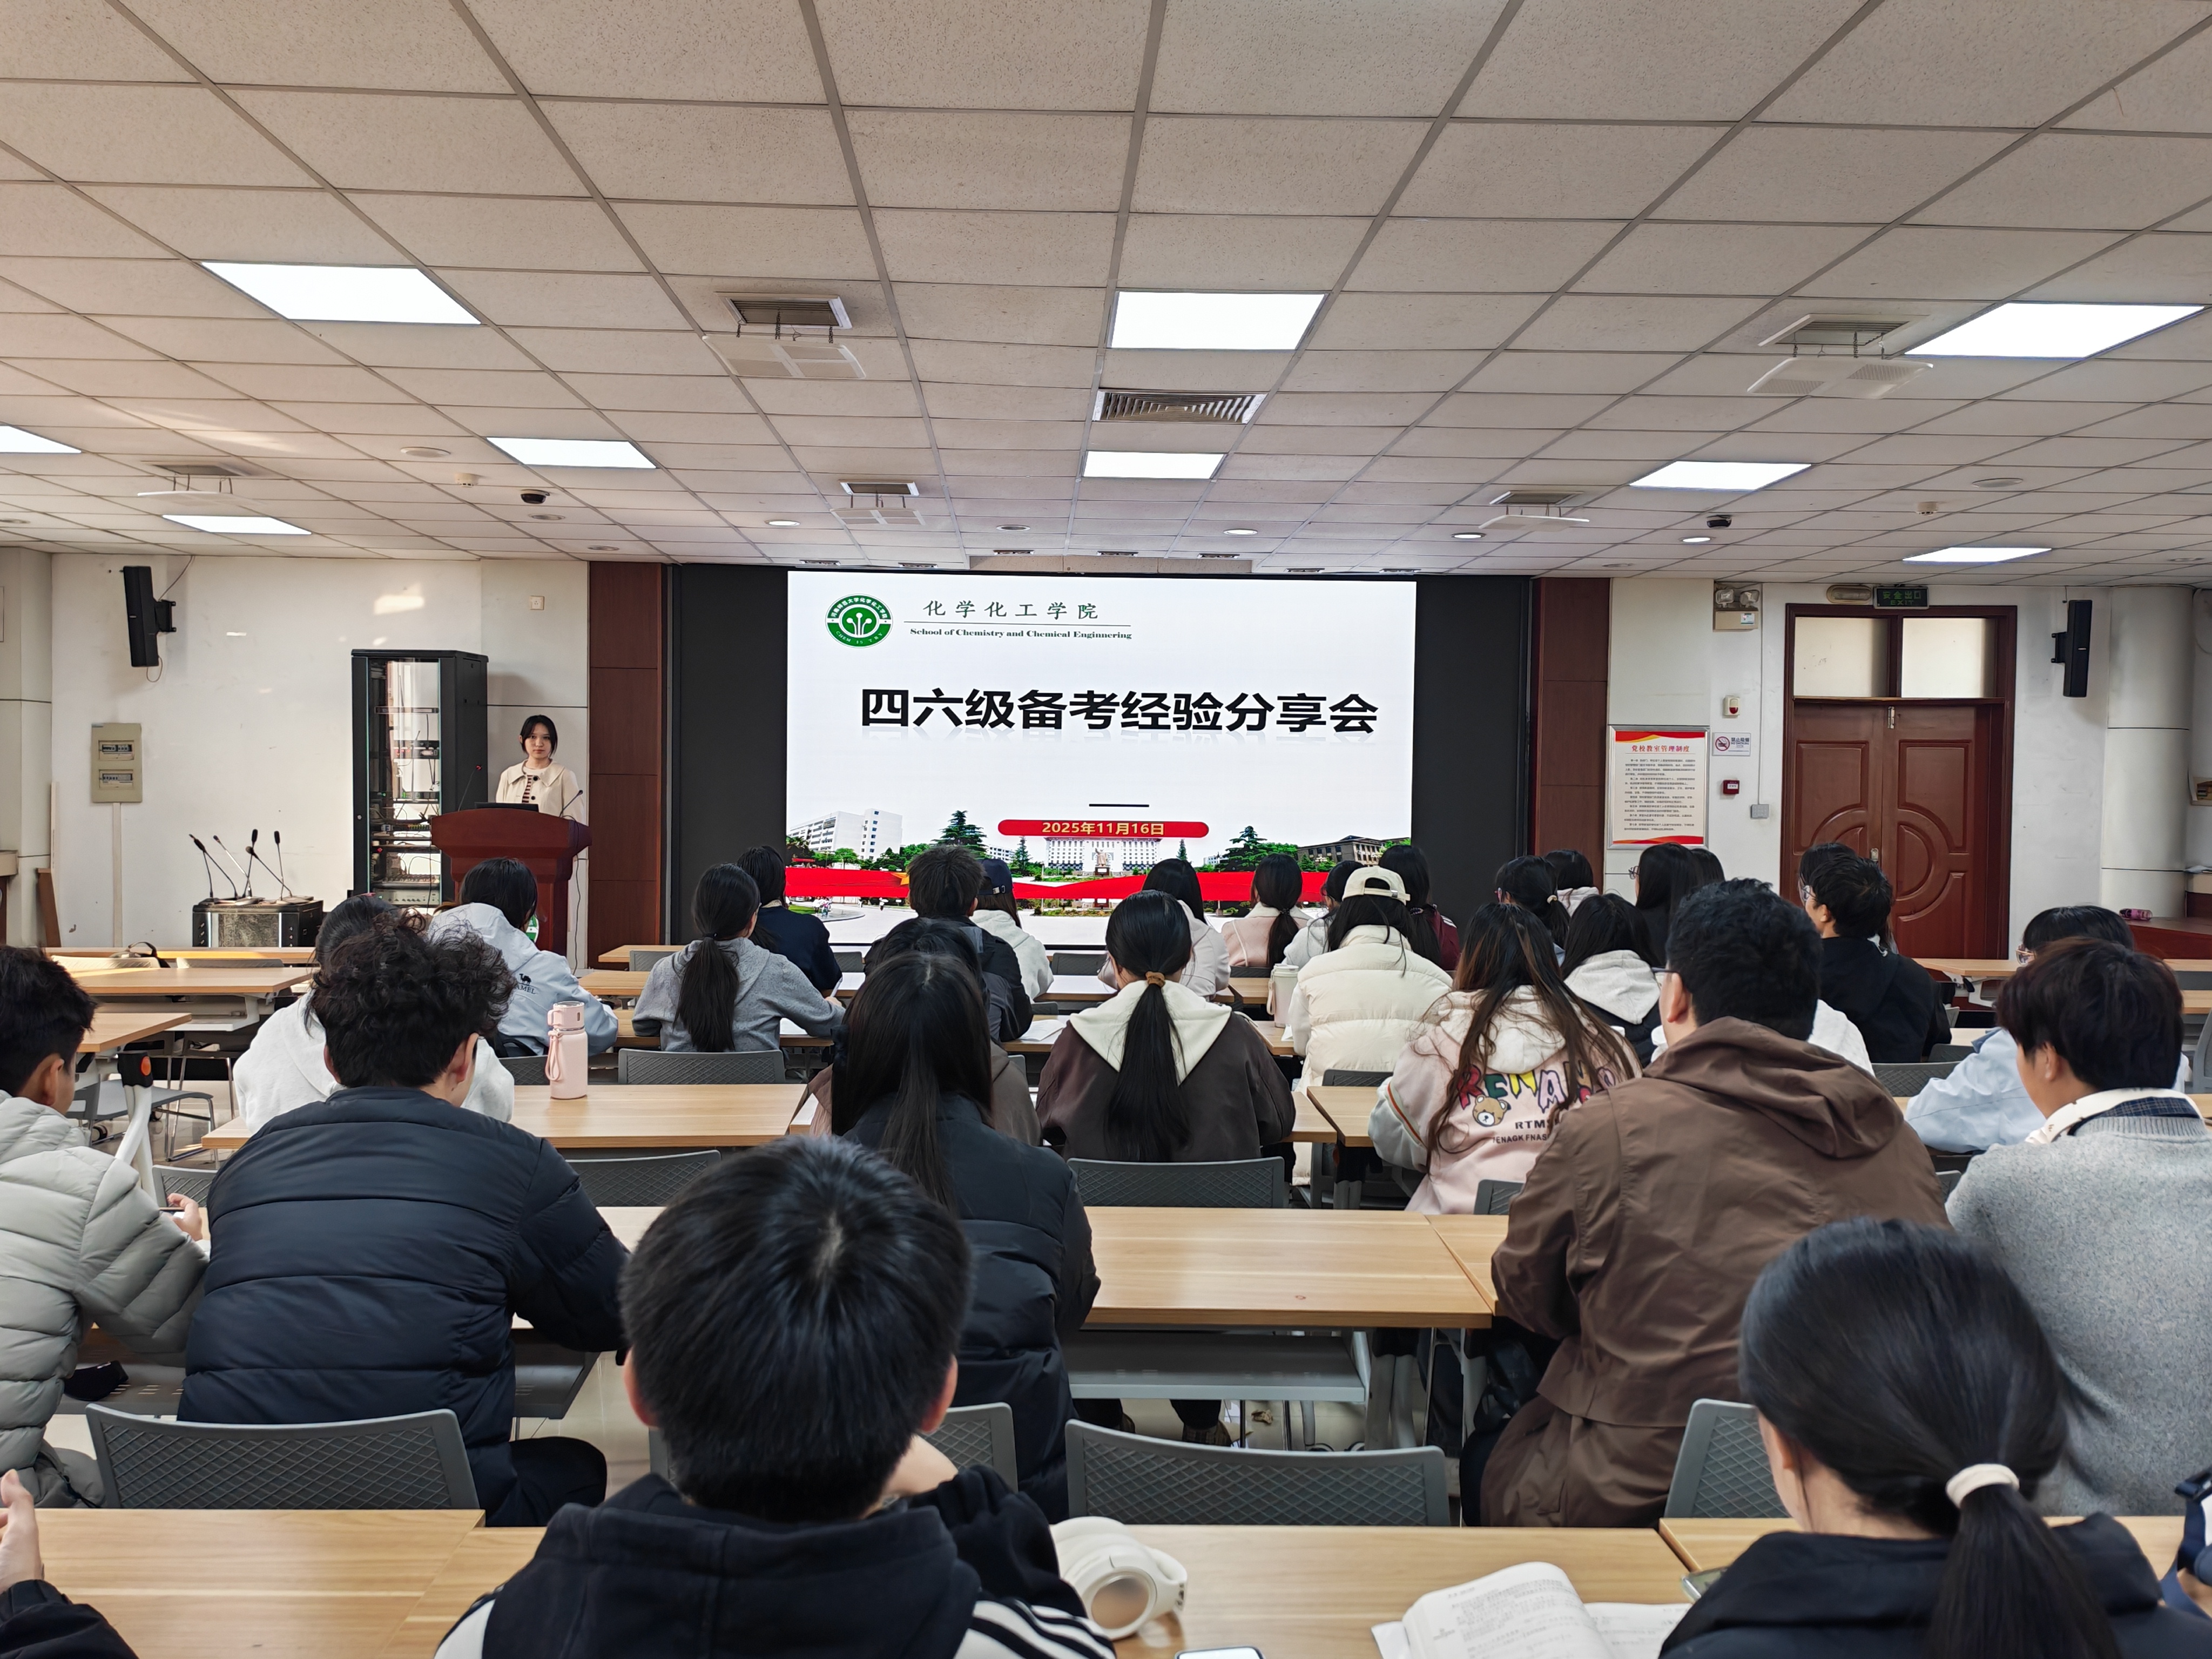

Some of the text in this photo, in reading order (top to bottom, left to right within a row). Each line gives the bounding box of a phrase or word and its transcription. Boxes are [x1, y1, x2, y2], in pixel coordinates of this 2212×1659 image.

[1883, 591, 1921, 599] 安全出口
[922, 600, 1098, 620] 化学化工学院
[956, 629, 1004, 638] Chemistry
[1074, 631, 1132, 639] Enginnering
[862, 687, 1379, 733] 四六级备考经验分享会
[1042, 821, 1164, 835] 2025年11月16日
[515, 984, 537, 994] AMEL
